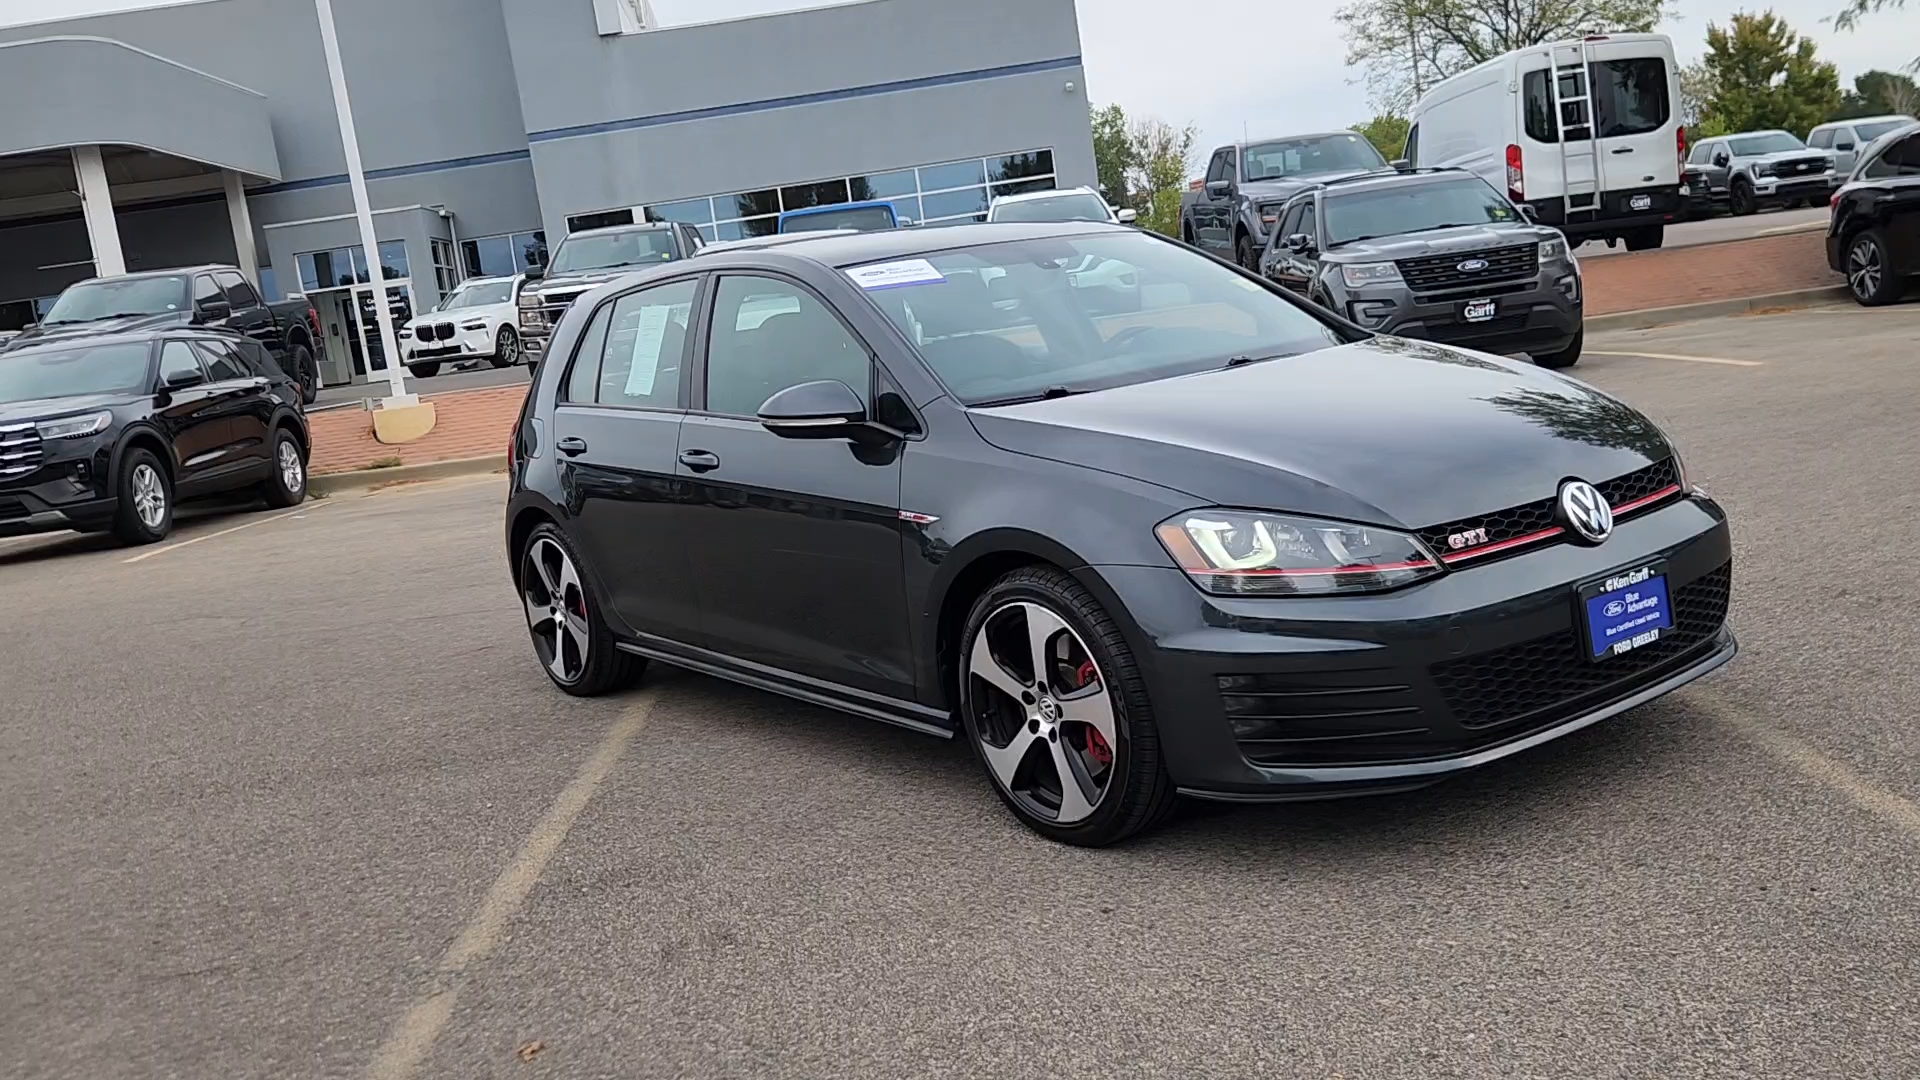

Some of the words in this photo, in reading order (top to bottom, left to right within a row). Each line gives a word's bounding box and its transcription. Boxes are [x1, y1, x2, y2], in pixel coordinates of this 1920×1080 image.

[1464, 303, 1496, 318] Garff
[1448, 527, 1489, 549] GTI
[1613, 576, 1630, 590] Ken
[1629, 567, 1649, 584] Garff
[1625, 593, 1639, 603] Blue
[1627, 596, 1658, 613] Advantage
[1613, 639, 1632, 655] FORD
[1632, 629, 1659, 648] GREELEY
